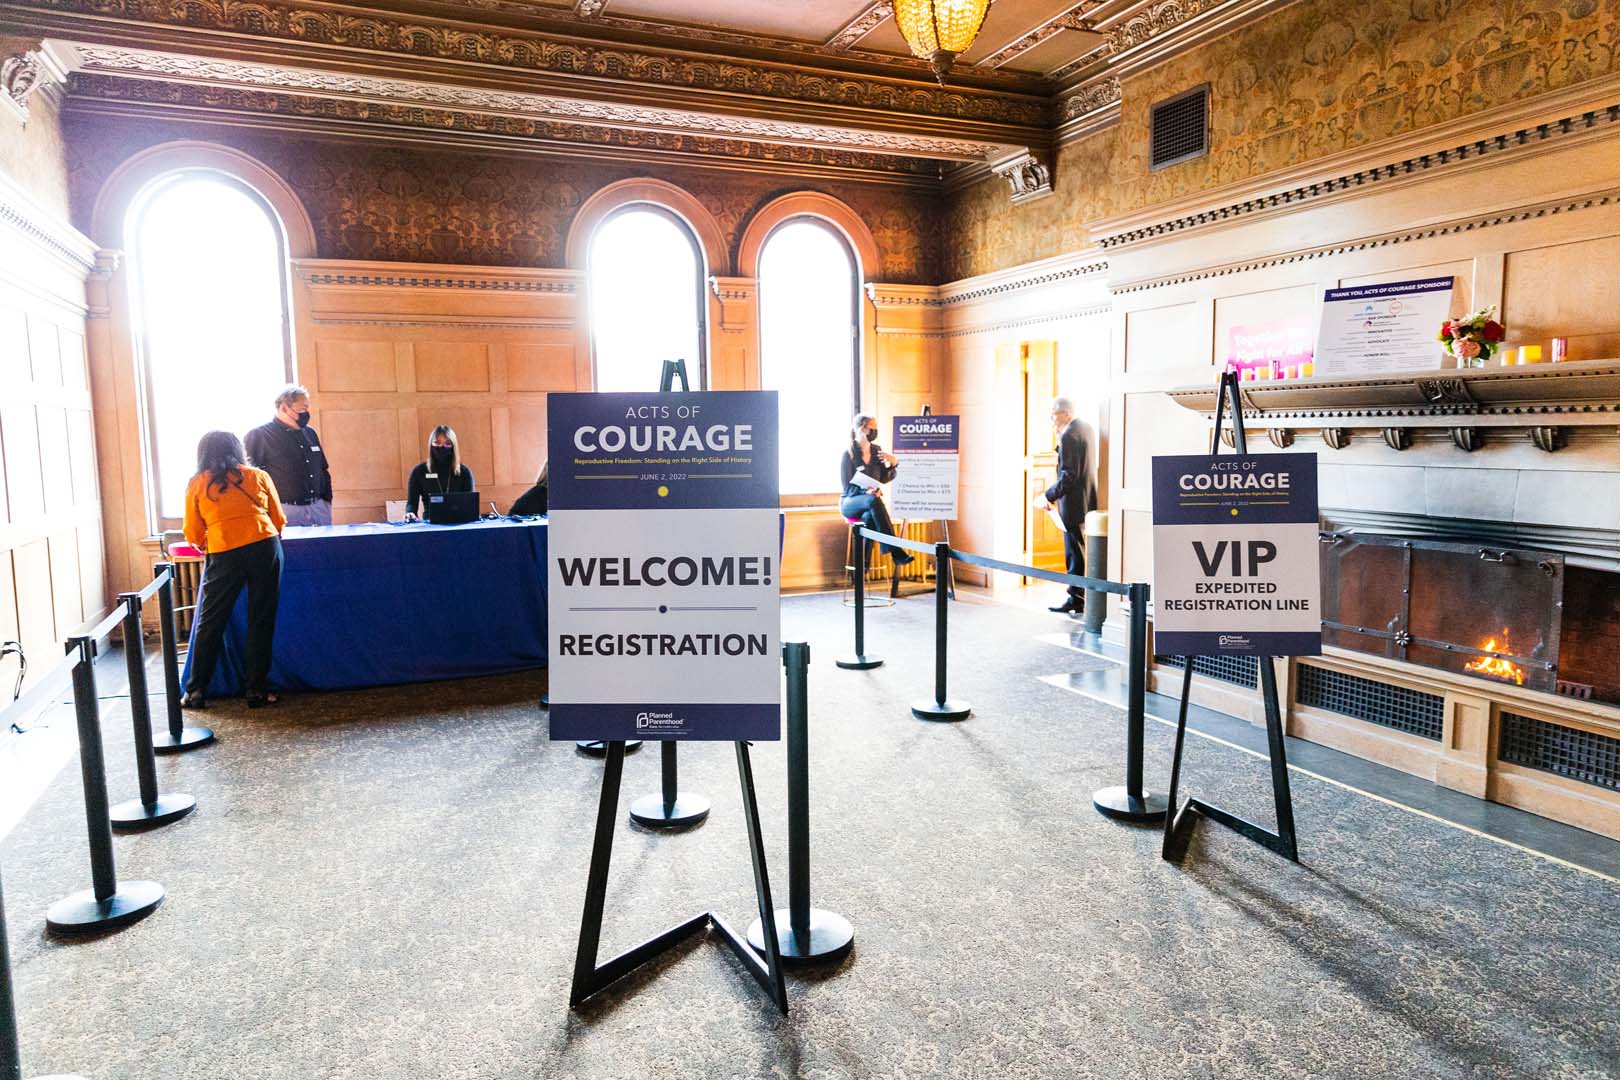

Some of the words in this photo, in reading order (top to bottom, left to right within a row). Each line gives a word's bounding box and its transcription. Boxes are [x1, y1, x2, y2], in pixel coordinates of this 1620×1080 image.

[625, 406, 670, 419] ACTS
[677, 406, 700, 418] OF
[899, 424, 952, 433] COURAGE
[574, 424, 753, 452] COURAGE
[1210, 462, 1238, 471] ACTS
[1242, 462, 1257, 470] OF
[1179, 472, 1290, 490] COURAGE
[1192, 540, 1277, 576] VIP
[557, 556, 772, 586] WELCOME!
[1195, 582, 1277, 593] EXPEDITED
[1165, 599, 1272, 610] REGISTRATION
[1276, 599, 1309, 610] LINE
[559, 634, 768, 656] REGISTRATION
